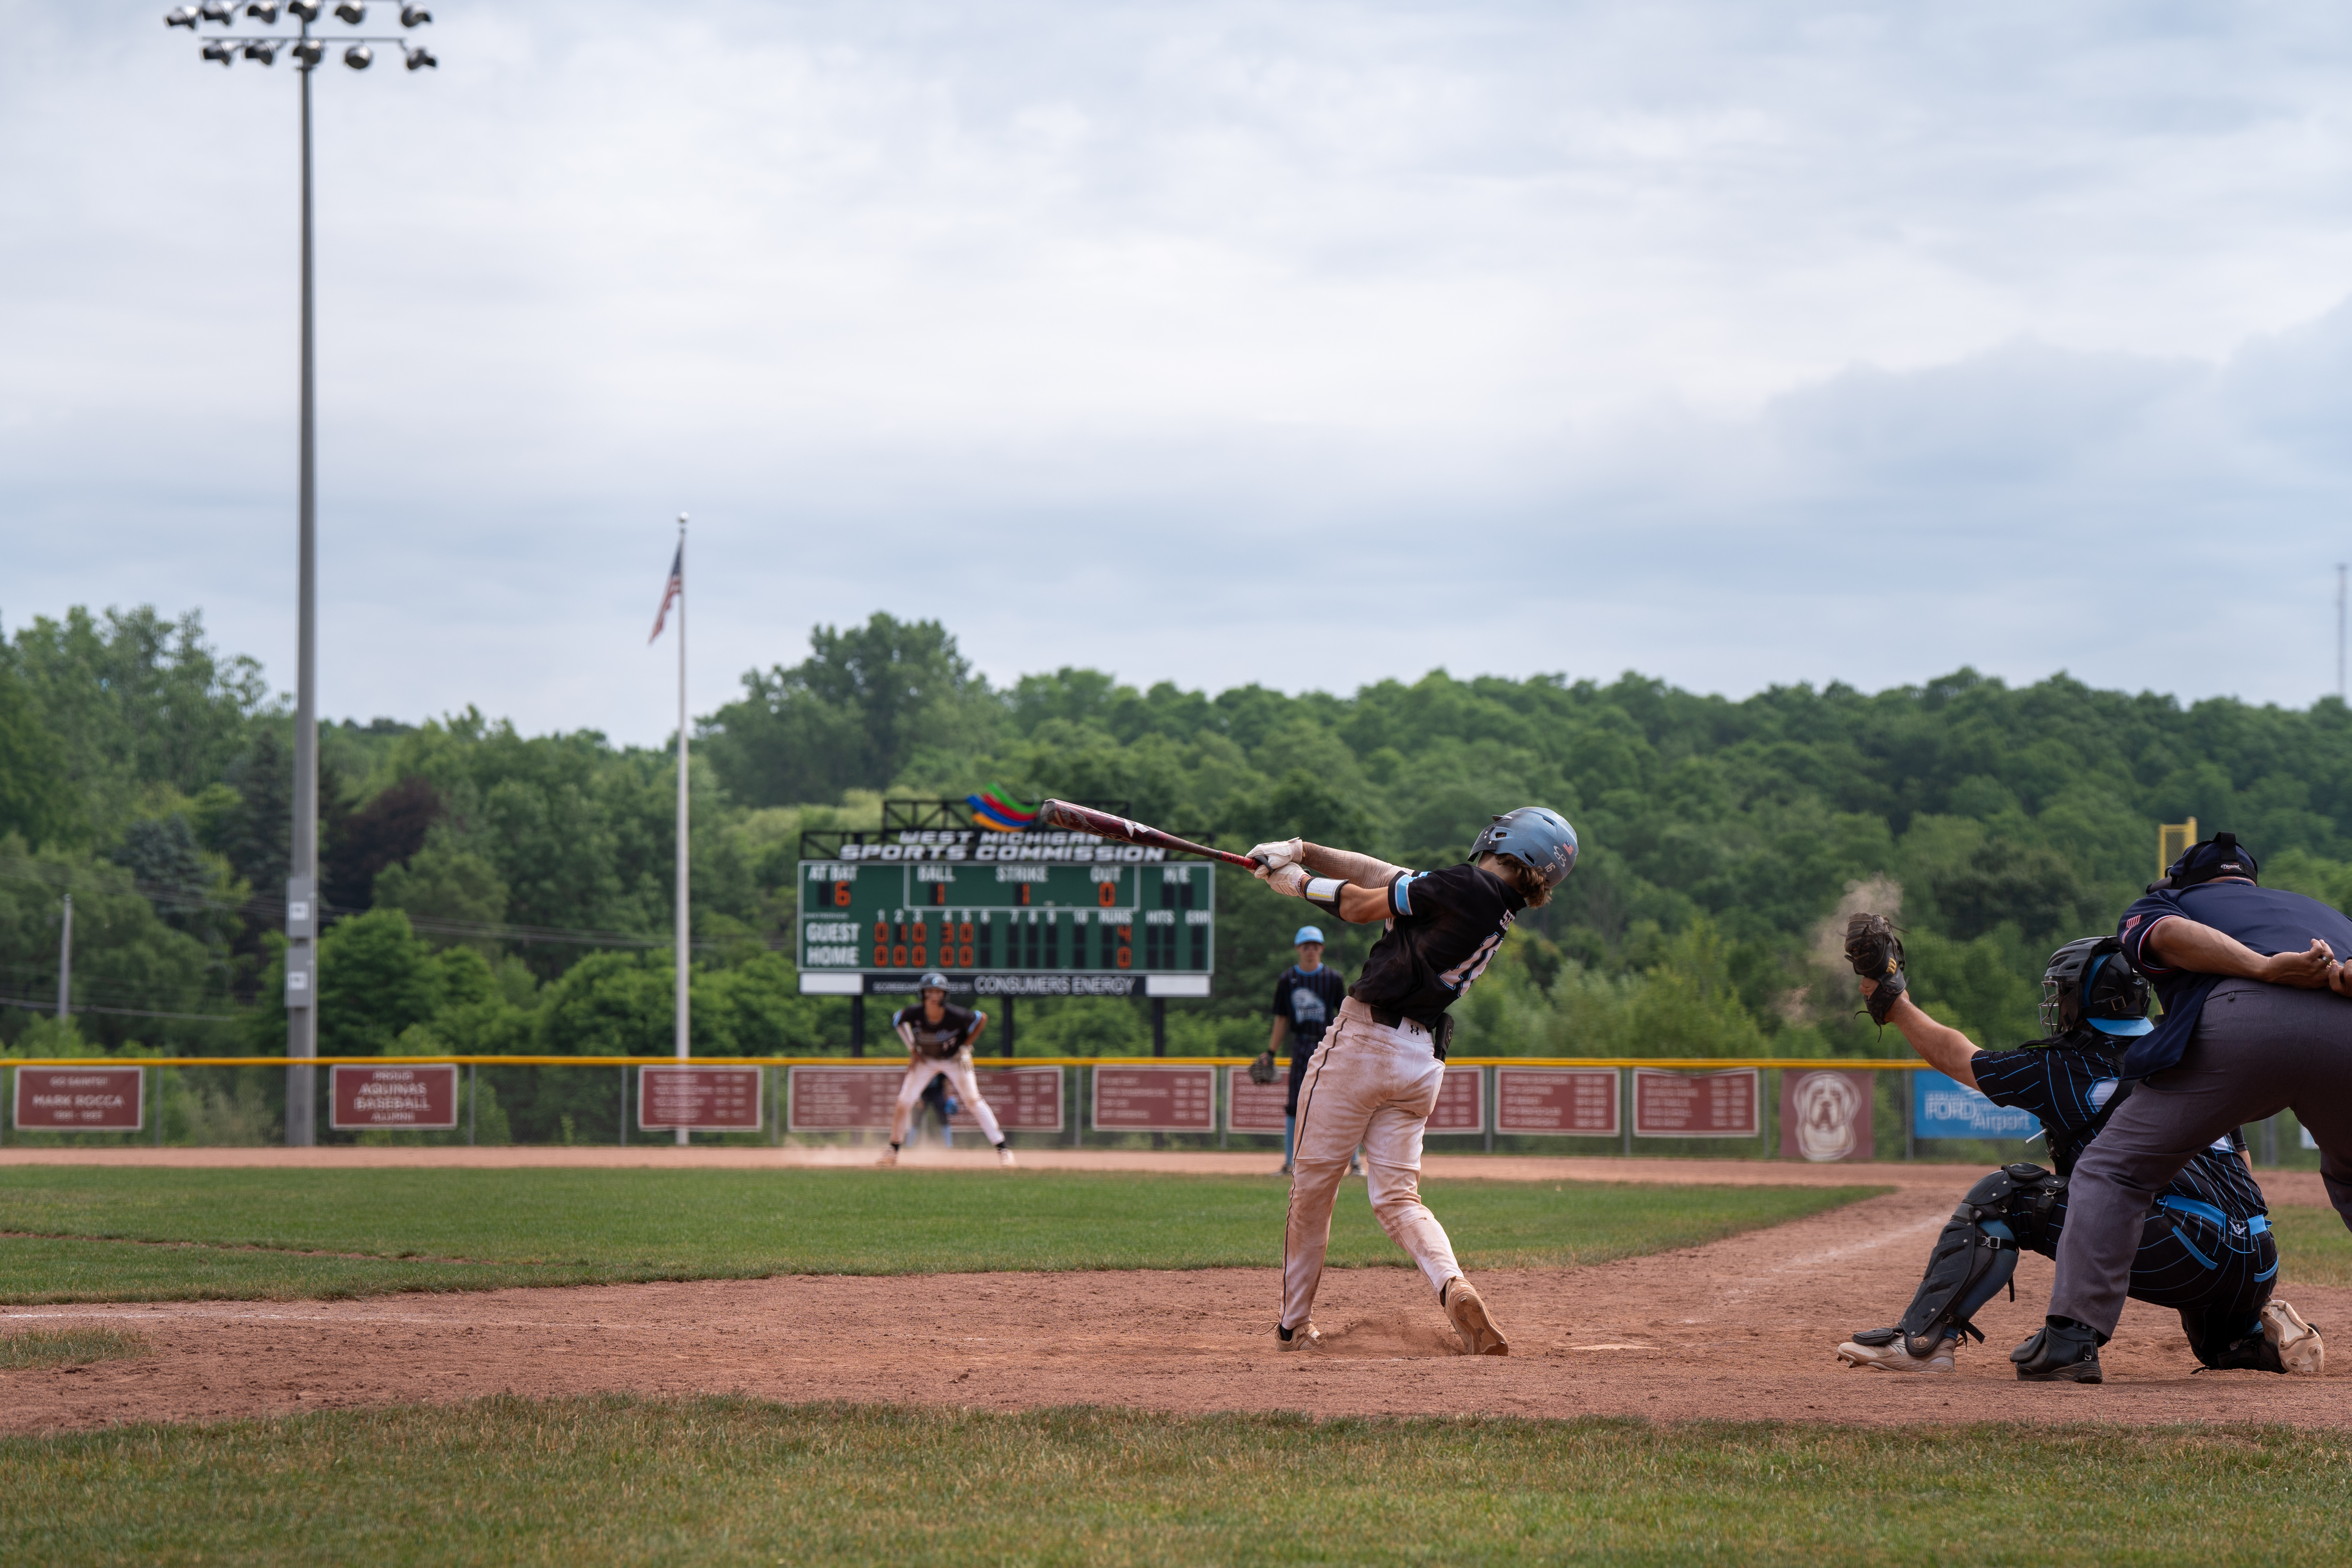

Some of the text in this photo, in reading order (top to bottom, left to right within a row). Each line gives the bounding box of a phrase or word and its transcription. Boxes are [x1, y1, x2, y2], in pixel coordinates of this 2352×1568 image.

[898, 830, 1104, 846] WEST MICHIGAN
[839, 844, 1166, 862] SPORTS COMMISSION
[808, 865, 859, 881] AT BAT
[917, 866, 956, 882] BALL
[995, 866, 1049, 882] STRIKE
[1090, 866, 1123, 883] OUT
[1545, 862, 1556, 872] 16
[834, 880, 852, 907] 6
[1098, 881, 1116, 907] 0
[877, 909, 885, 922] 1
[893, 908, 905, 923] 2
[912, 909, 924, 923] 3
[942, 909, 953, 922] 4
[961, 909, 972, 923] 5
[980, 909, 991, 924] 6
[1009, 909, 1020, 924] 7
[1028, 909, 1039, 924] 8
[1046, 909, 1057, 925] 9
[1073, 909, 1089, 925] 10
[1098, 910, 1133, 925] RUNS
[1145, 909, 1175, 925] HITS
[806, 922, 861, 943] GUEST
[874, 922, 889, 943] 0
[912, 922, 927, 943] 0
[959, 922, 974, 943] 0
[806, 945, 1132, 969] HOME 0 0 0 0 0 0
[974, 975, 1071, 995] CONSUMERS
[1071, 976, 1136, 995] ENERGY
[358, 1082, 427, 1097] AQUINAS
[32, 1094, 125, 1109] MARK ROCCA
[354, 1096, 432, 1111] BASEBALL
[1924, 1101, 1976, 1120] FORD
[1970, 1113, 2031, 1135] Airport
